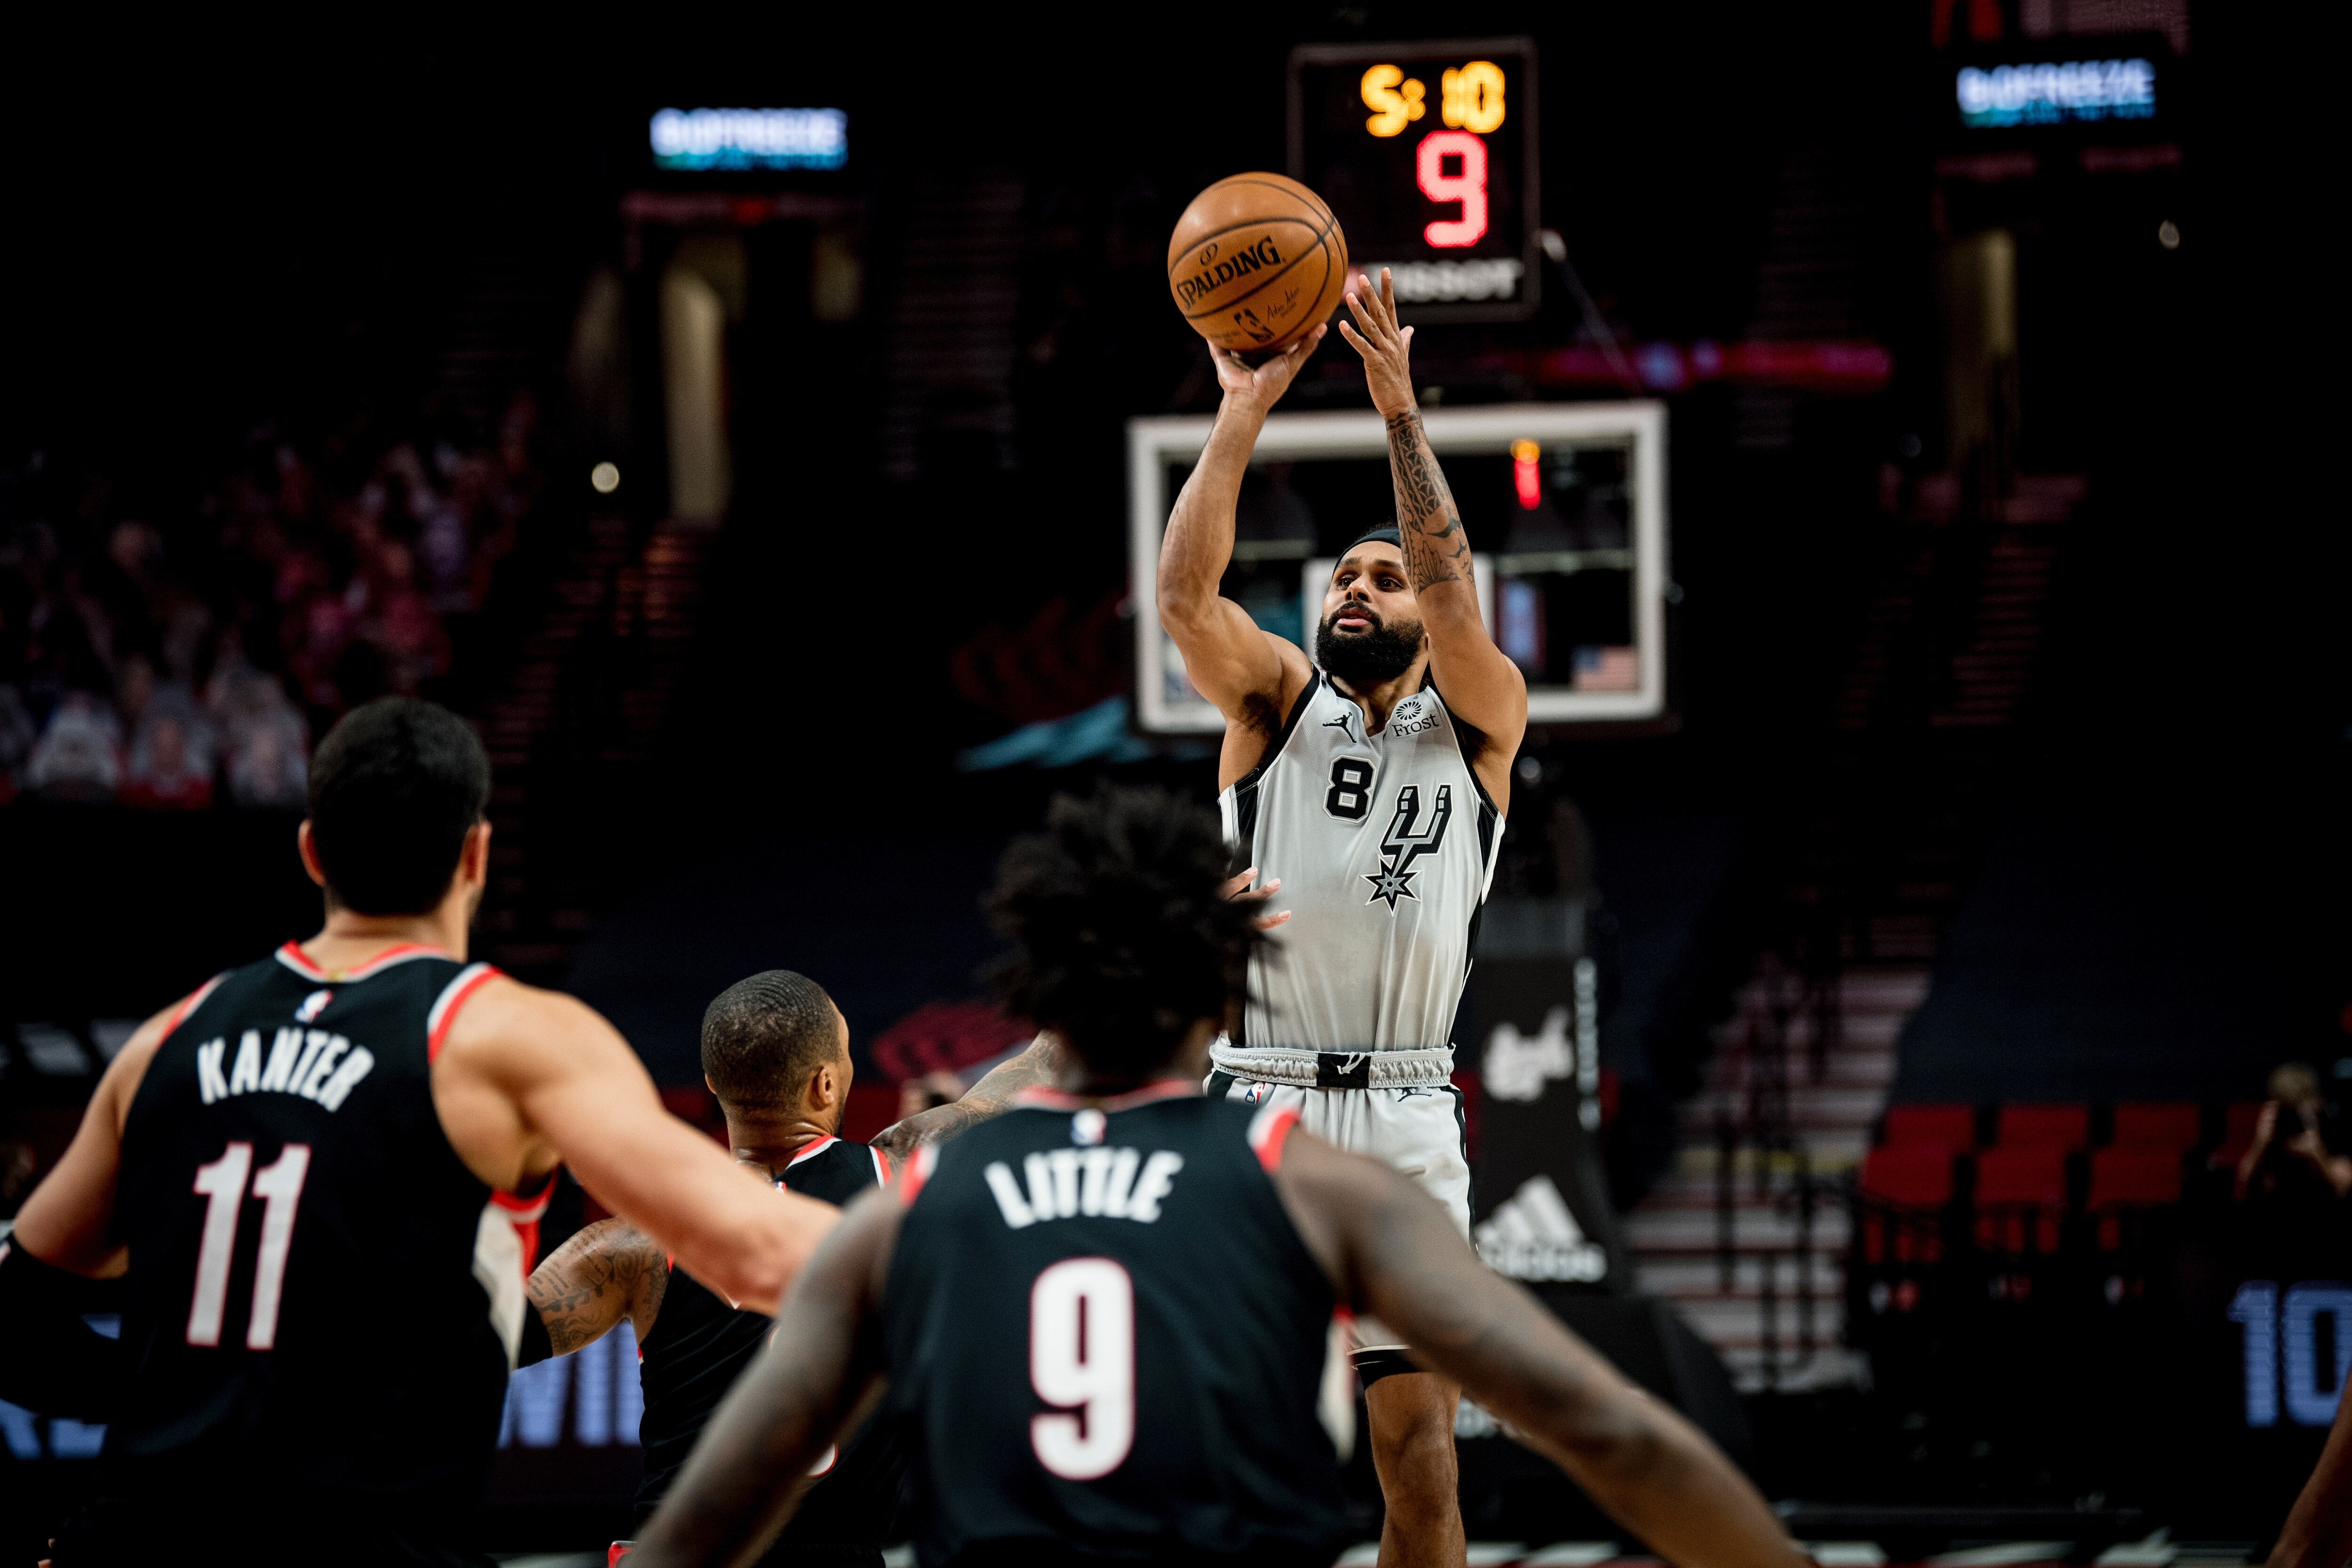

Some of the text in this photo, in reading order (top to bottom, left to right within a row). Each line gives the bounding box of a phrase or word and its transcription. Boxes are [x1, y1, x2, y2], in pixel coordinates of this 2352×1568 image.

[1361, 61, 1505, 137] 5:10
[1417, 130, 1488, 247] 9
[1176, 235, 1281, 311] SPALDING
[1391, 714, 1439, 737] Frost
[1323, 755, 1377, 823] 8
[197, 1026, 375, 1113] KANTER
[984, 1146, 1184, 1229] LITTLE
[186, 1141, 312, 1351] 11
[1029, 1255, 1136, 1481] 9
